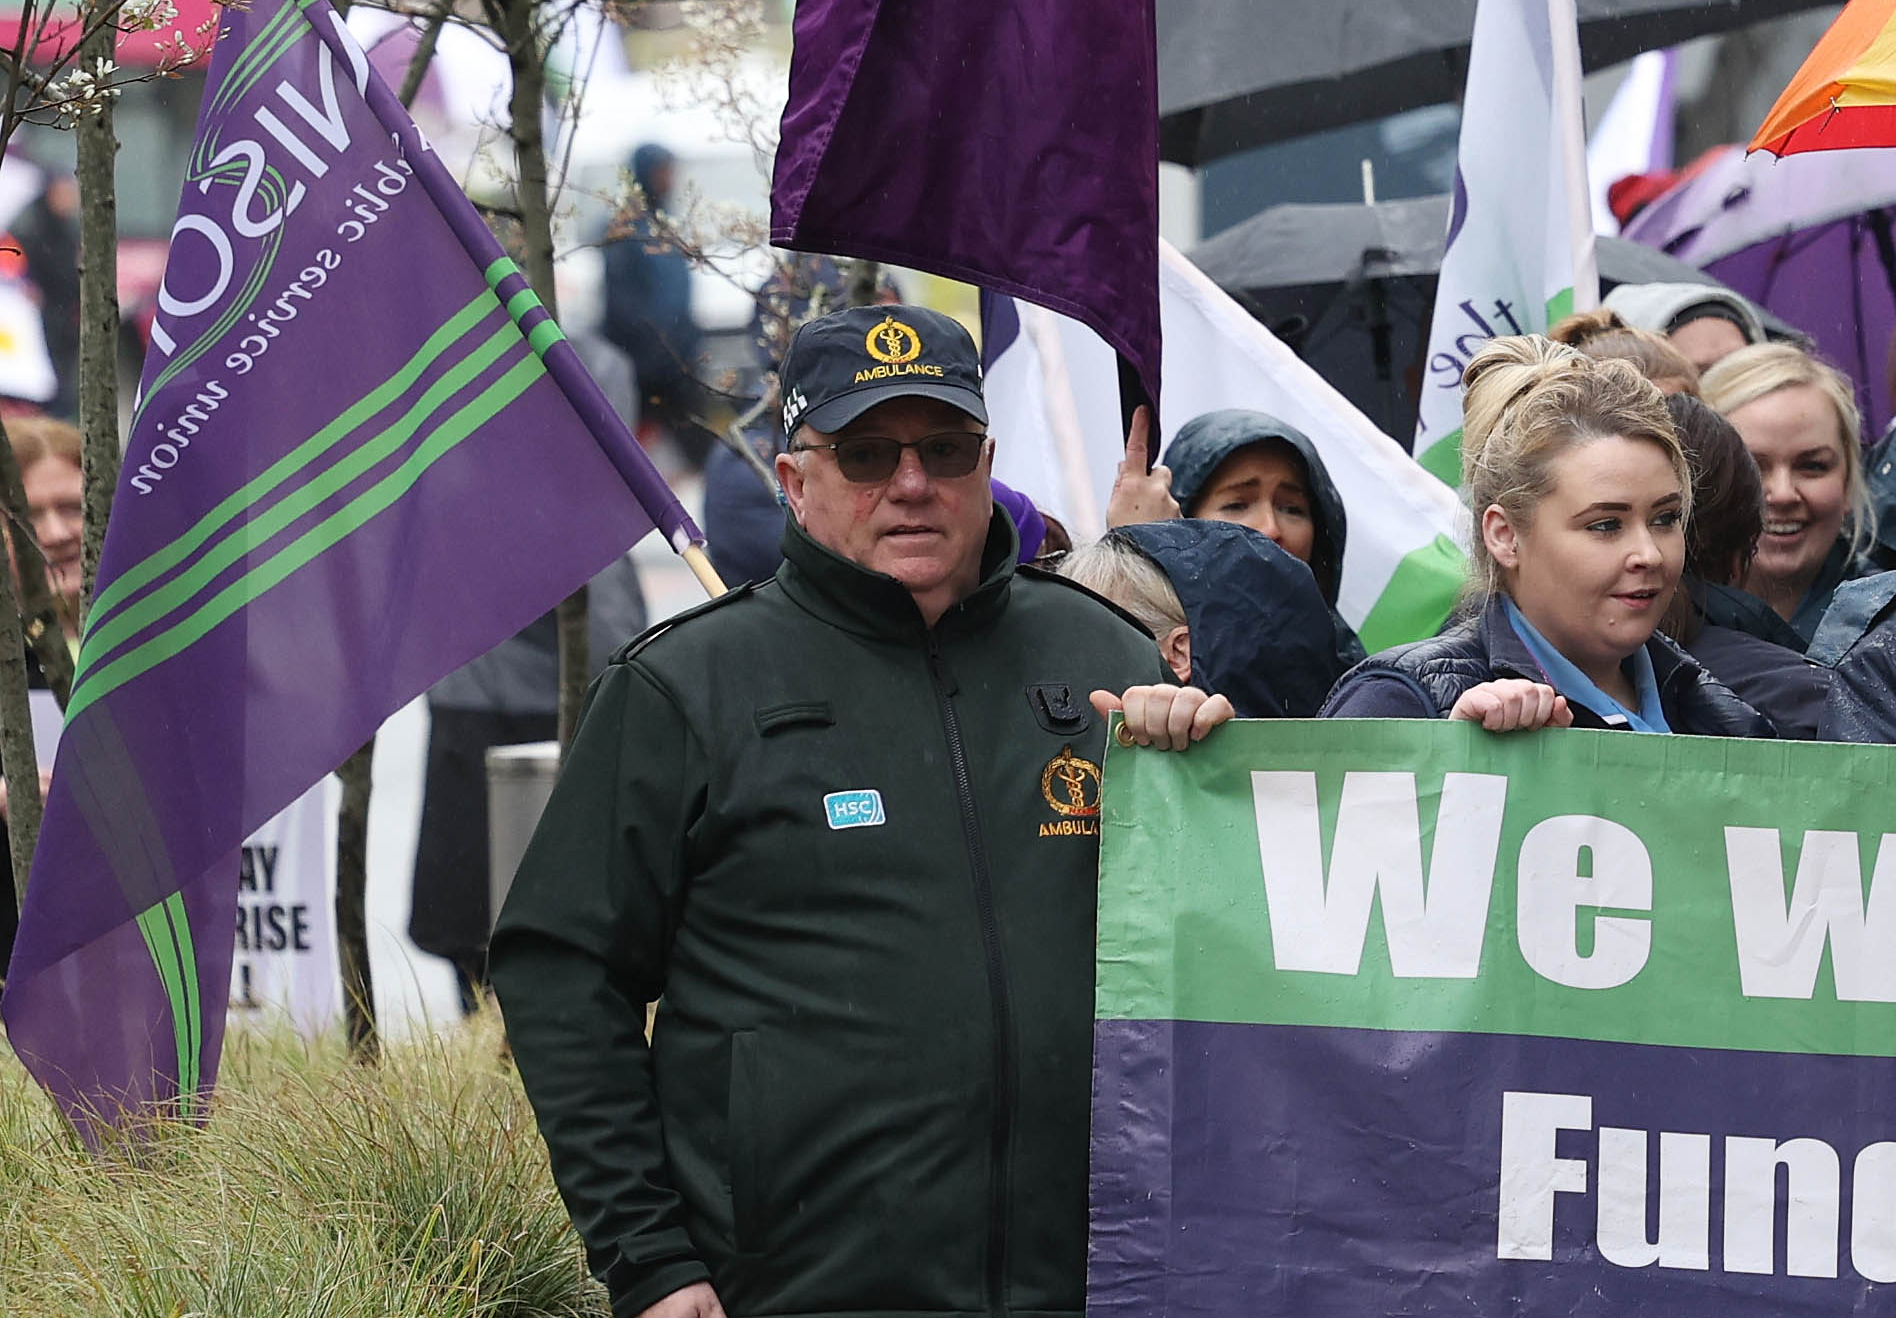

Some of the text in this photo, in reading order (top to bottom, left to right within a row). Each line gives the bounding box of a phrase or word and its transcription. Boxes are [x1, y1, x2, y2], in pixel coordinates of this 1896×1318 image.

[854, 363, 943, 384] AMBULANCE
[833, 800, 872, 819] HSC
[1039, 819, 1099, 837] AMBULA
[240, 846, 278, 892] AY
[1252, 768, 1654, 991] We
